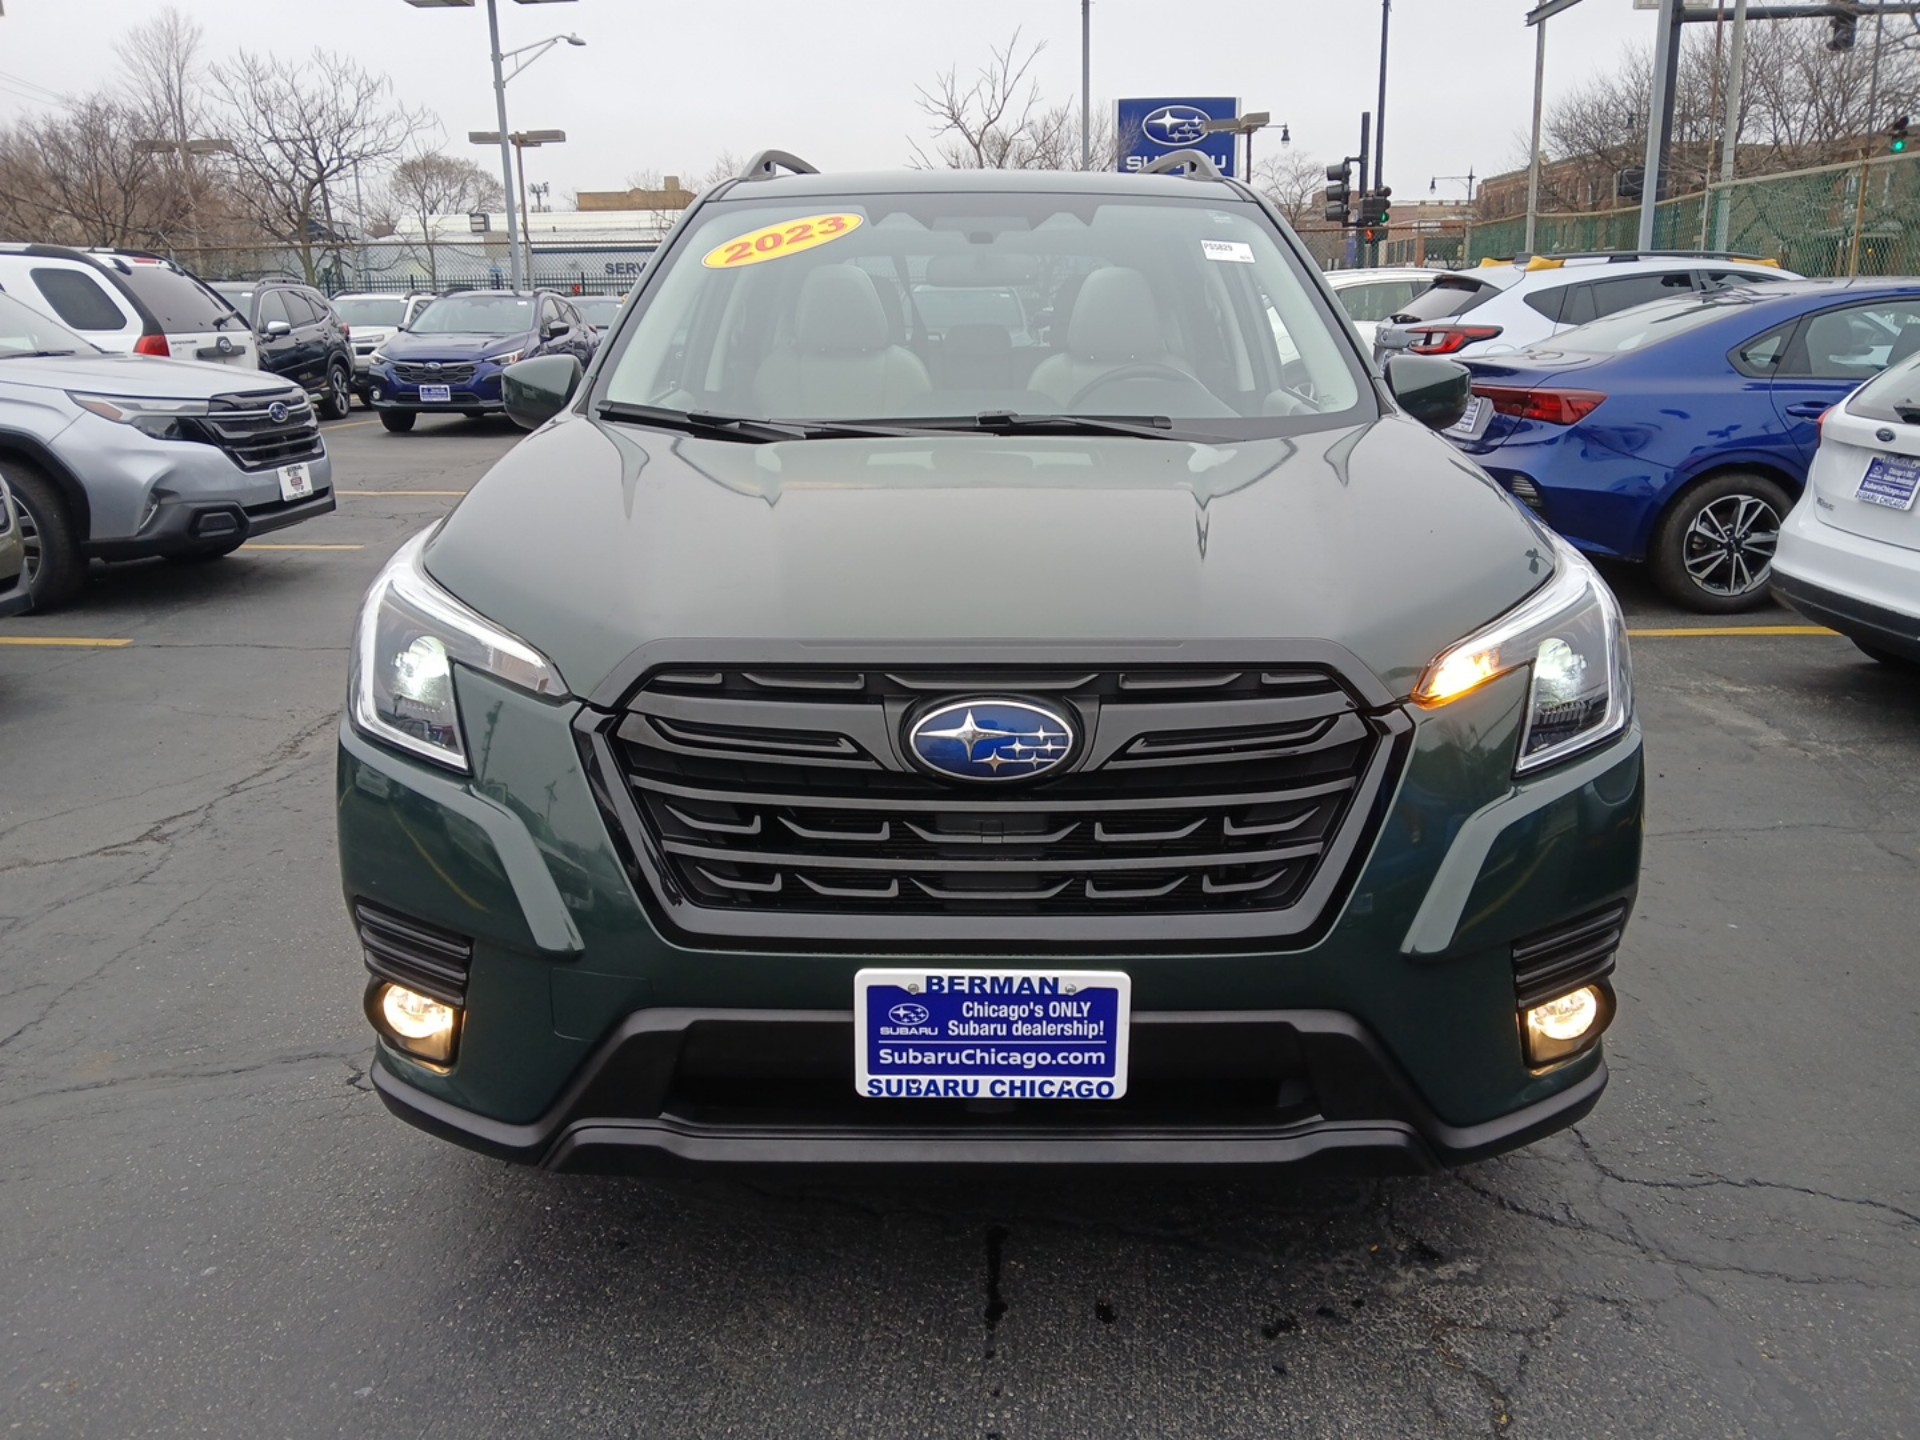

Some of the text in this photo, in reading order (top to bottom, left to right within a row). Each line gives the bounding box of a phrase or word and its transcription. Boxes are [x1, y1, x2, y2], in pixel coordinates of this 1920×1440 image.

[724, 216, 847, 264] 2023
[926, 975, 1060, 994] BERMAN
[962, 1001, 1092, 1021] Chicago's ONLY
[879, 1026, 939, 1036] SUBARU
[947, 1019, 1105, 1040] Subaru dealership!
[878, 1047, 1106, 1069] SubaruChicago.com
[867, 1078, 1115, 1098] SUBARU CHICAGO
